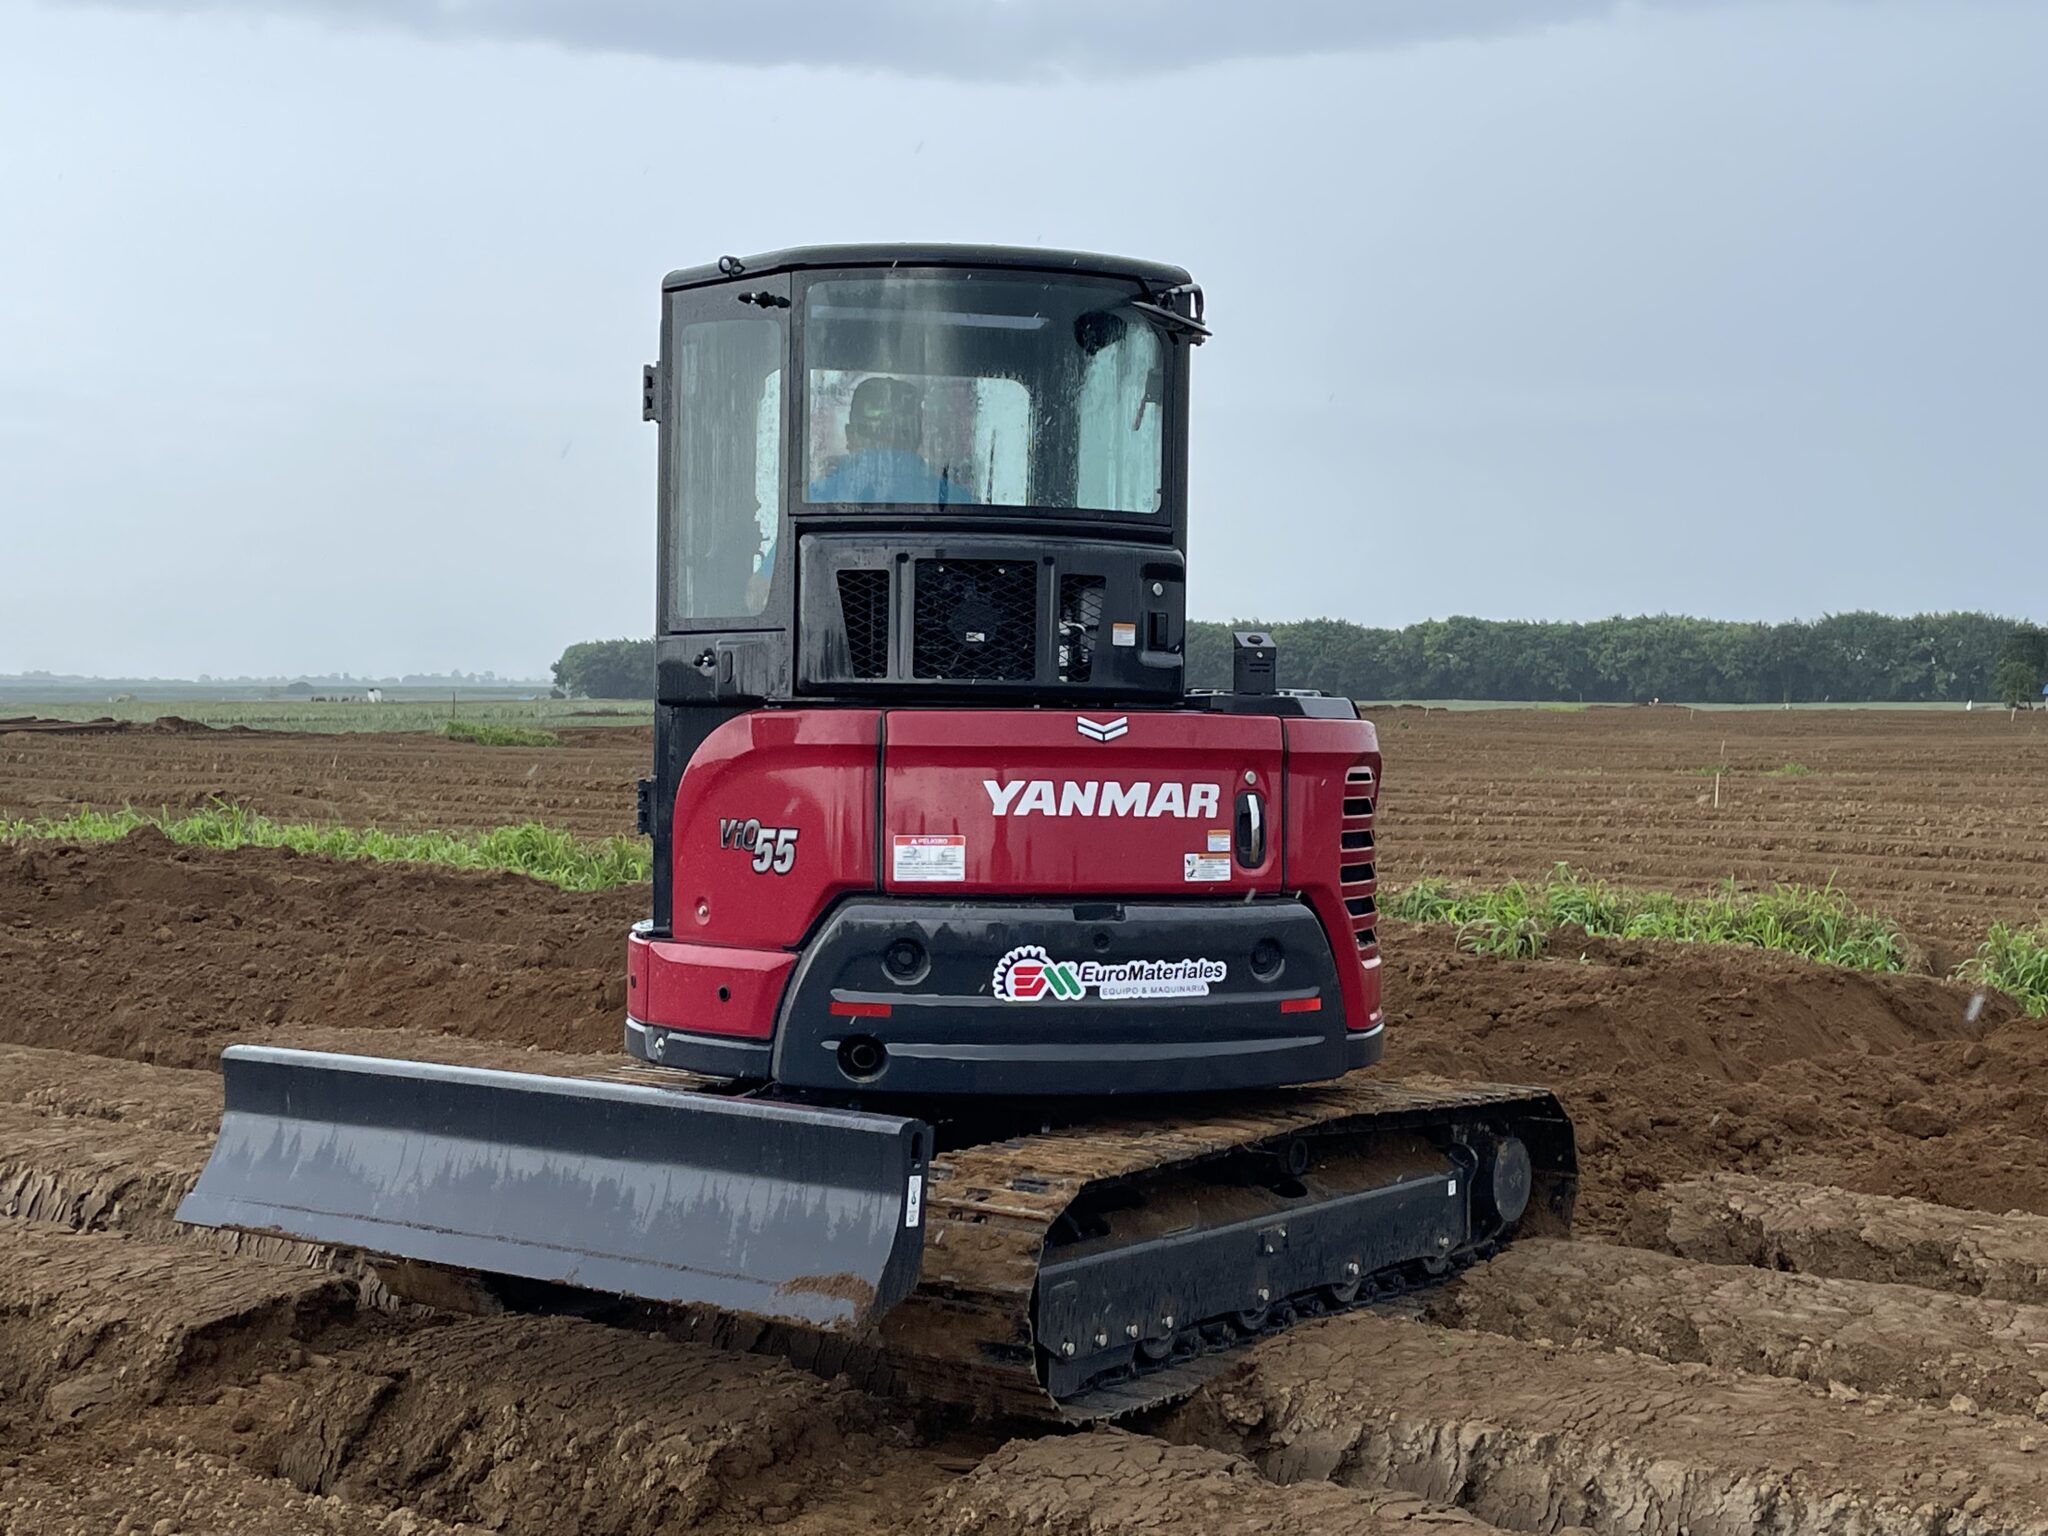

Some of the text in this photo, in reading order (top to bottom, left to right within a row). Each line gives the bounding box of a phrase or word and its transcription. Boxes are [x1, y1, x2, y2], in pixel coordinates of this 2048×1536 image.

[983, 780, 1220, 818] YANMAR
[1081, 961, 1223, 983] EuroMateriales
[1102, 986, 1138, 996] EQUIPO
[1150, 984, 1206, 995] MAQUINARIA
